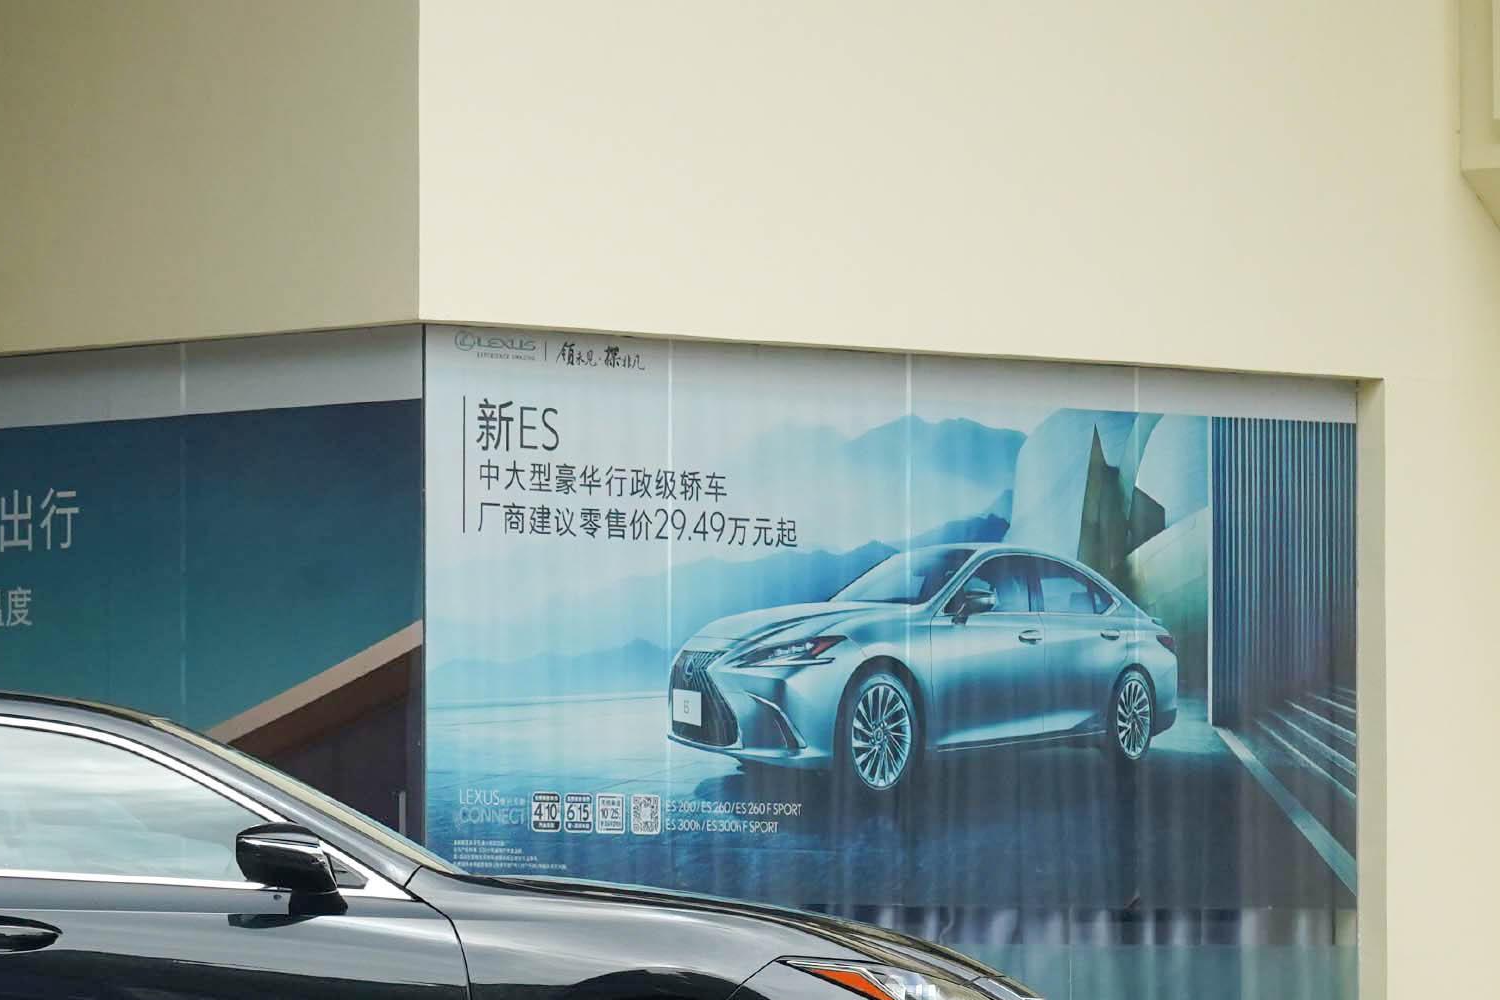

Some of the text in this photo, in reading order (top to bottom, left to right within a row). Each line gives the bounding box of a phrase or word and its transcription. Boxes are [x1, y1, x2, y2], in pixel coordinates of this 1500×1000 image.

[476, 335, 536, 351] LEXUS
[476, 398, 560, 452] 新ES
[478, 458, 728, 502] 中大型豪华行政级轿车
[477, 502, 799, 548] 厂商建议零售价29.49万元起
[459, 788, 500, 806] LEXUS
[460, 806, 525, 825] CONNECT
[773, 803, 802, 817] SPORT
[749, 821, 779, 833] SPORT
